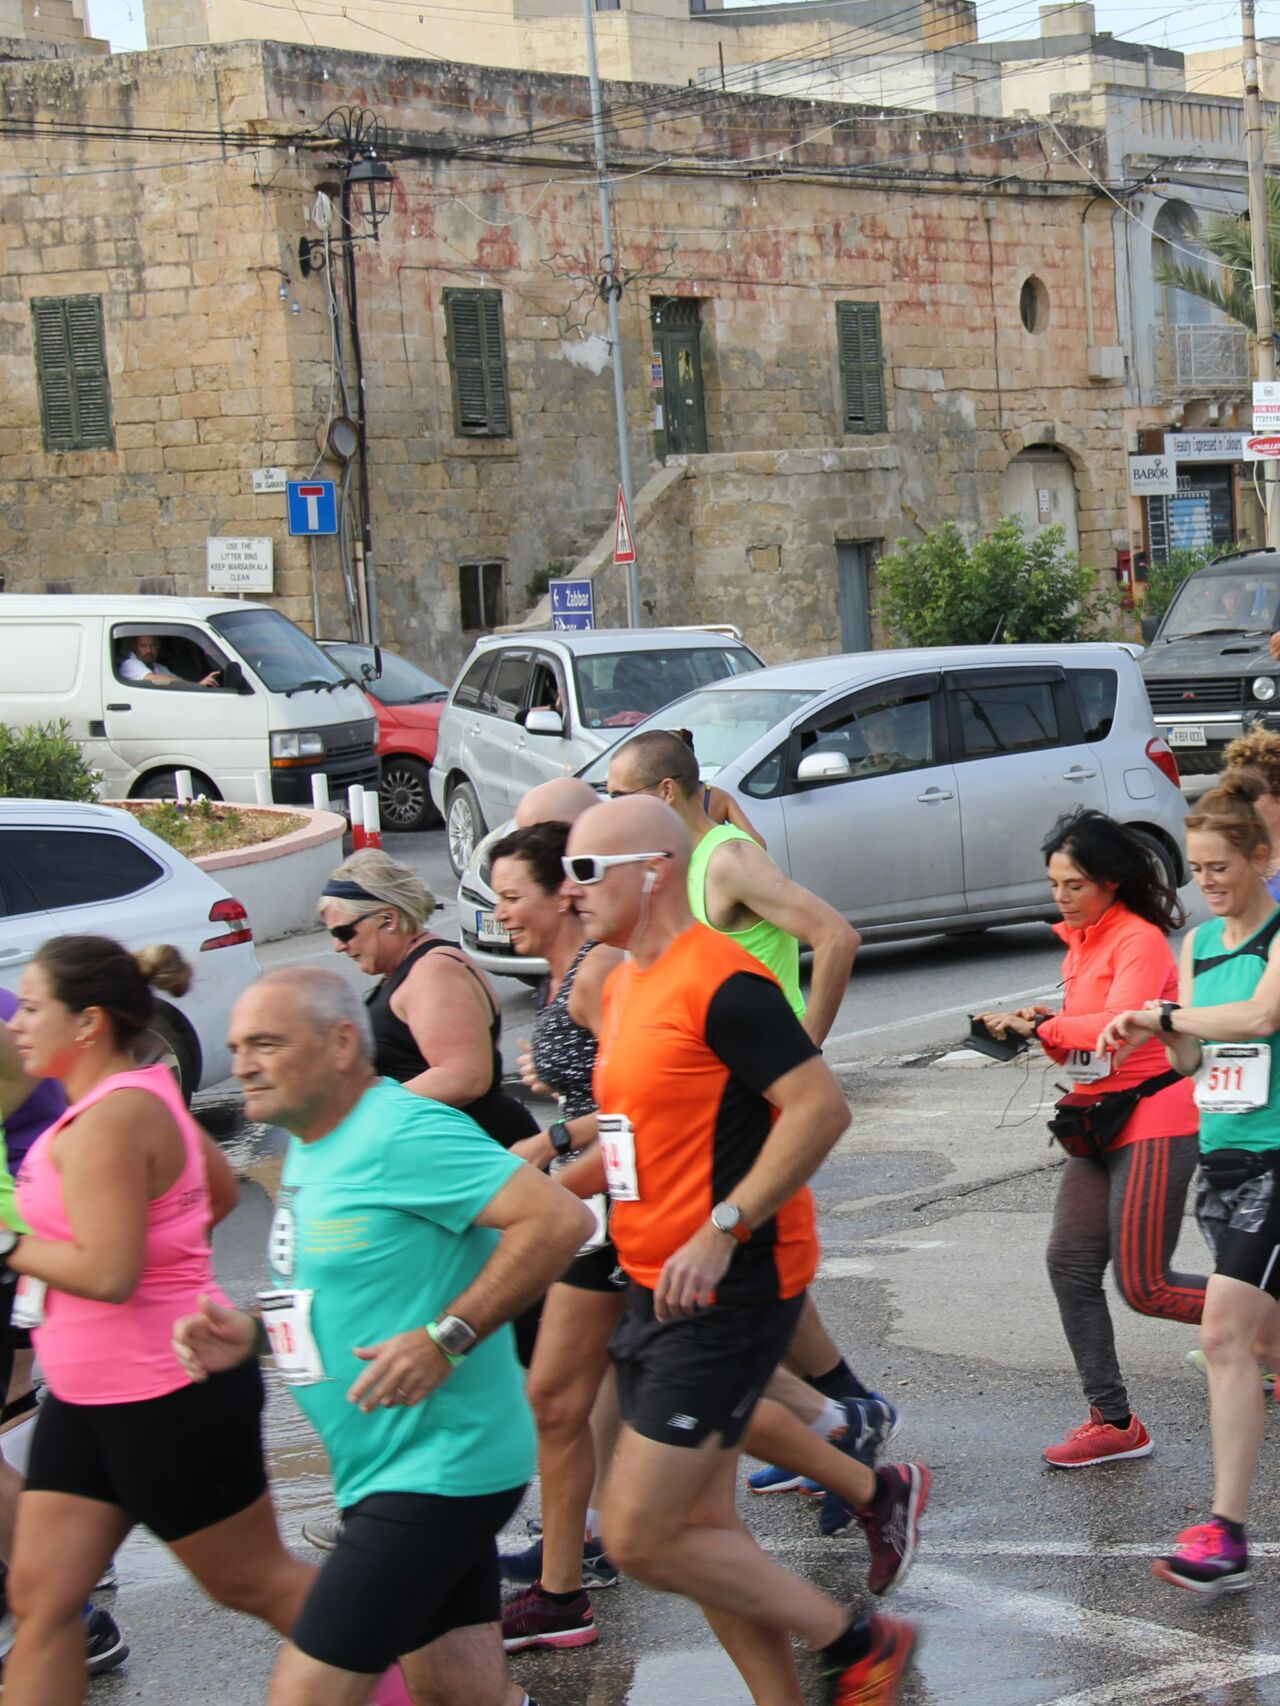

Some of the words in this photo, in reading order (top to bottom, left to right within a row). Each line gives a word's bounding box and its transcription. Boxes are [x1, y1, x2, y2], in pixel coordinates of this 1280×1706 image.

[1133, 467, 1169, 480] BABOR
[226, 543, 240, 551] USE
[221, 553, 242, 561] LITTER
[210, 563, 226, 571] KEEP
[1207, 1065, 1244, 1091] 511
